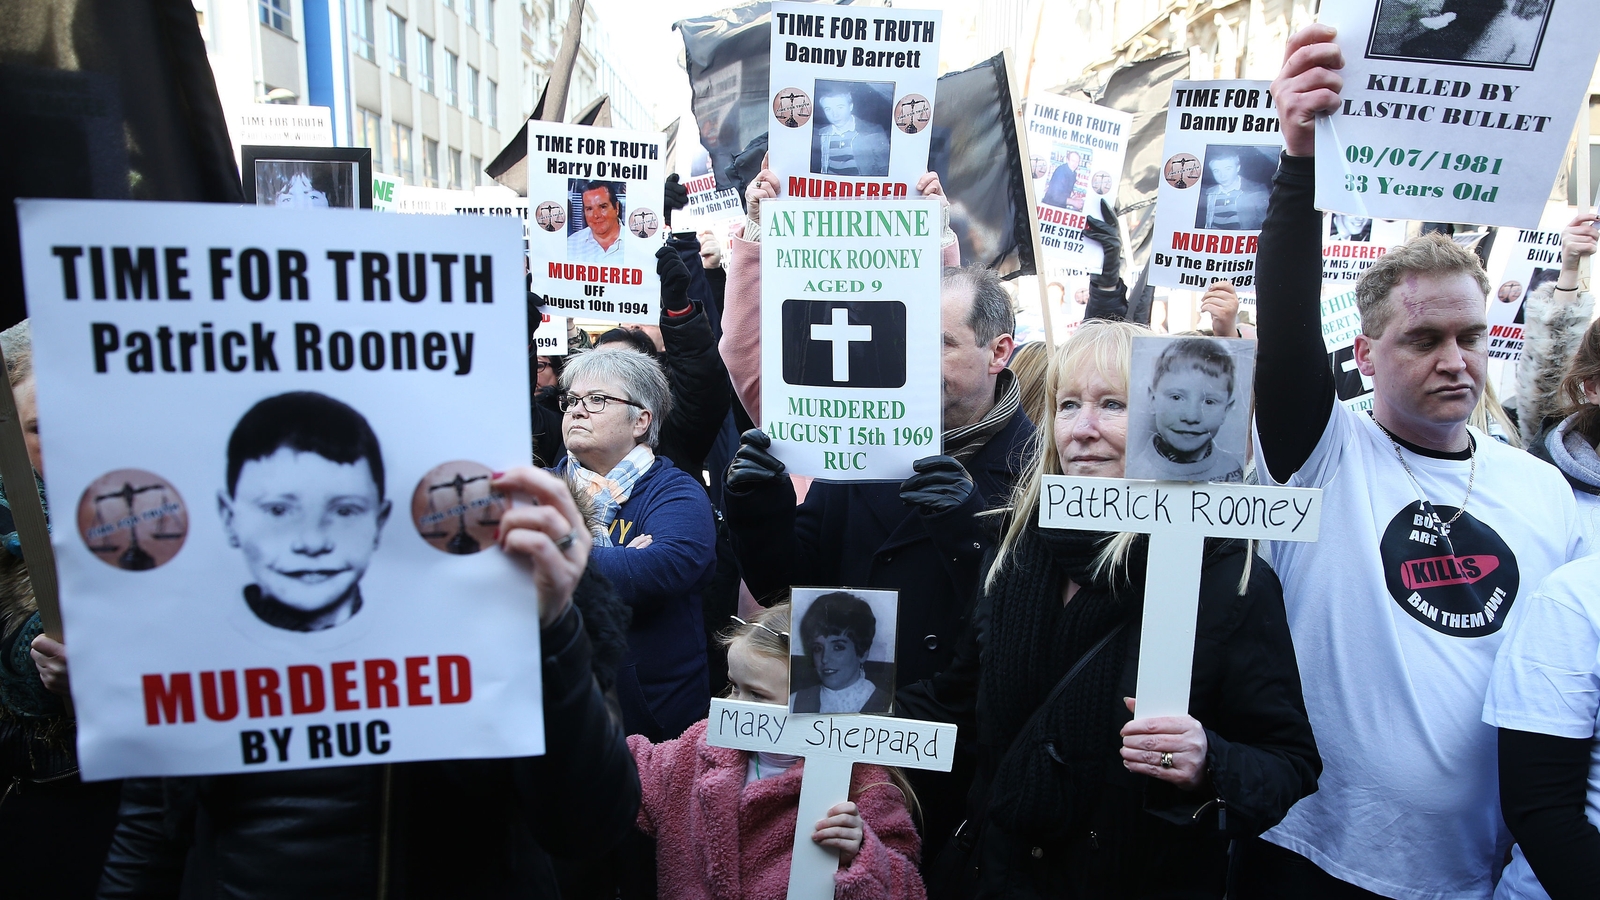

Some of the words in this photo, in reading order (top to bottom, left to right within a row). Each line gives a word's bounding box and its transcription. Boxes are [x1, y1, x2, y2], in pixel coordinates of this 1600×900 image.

[777, 13, 825, 38] TIME
[830, 16, 867, 41] FOR
[873, 19, 935, 43] TRUTH
[785, 42, 847, 68] Danny
[852, 46, 921, 69] Barrett
[1175, 89, 1221, 108] TIME
[1224, 89, 1260, 109] FOR
[1366, 73, 1471, 98] KILLED
[1477, 83, 1520, 103] BY
[292, 117, 325, 127] TRUTH
[1033, 103, 1059, 122] TIME
[1062, 110, 1082, 127] FOR
[1086, 116, 1121, 136] TRUTH
[1180, 113, 1239, 133] Danny
[1440, 107, 1552, 133] BULLET
[535, 134, 573, 154] TIME
[577, 137, 606, 157] FOR
[610, 140, 659, 161] TRUTH
[1029, 119, 1068, 140] Frankie
[1070, 129, 1119, 153] McKeown
[547, 157, 593, 178] Harry
[597, 161, 648, 181] O'Neill
[1345, 144, 1504, 176] 09/07/1981
[690, 195, 699, 206] BY
[700, 192, 713, 203] THE
[788, 176, 908, 200] MURDERED
[1344, 173, 1368, 194] 33
[1376, 176, 1445, 199] Years
[1452, 182, 1499, 203] Old
[706, 202, 722, 214] 16th
[723, 197, 740, 209] 1972
[768, 211, 796, 237] AN
[803, 209, 930, 238] FHIRINNE
[1040, 223, 1057, 235] THE
[1058, 227, 1085, 241] STATE
[1041, 236, 1061, 249] 16th
[1063, 241, 1085, 253] 1972
[1518, 230, 1545, 245] TIME
[776, 248, 842, 270] PATRICK
[847, 248, 922, 270] ROONEY
[1154, 253, 1172, 267] By
[1176, 255, 1202, 270] The
[1206, 258, 1254, 272] British
[1330, 260, 1349, 269] MI5
[1527, 248, 1554, 264] Billy
[51, 246, 191, 302] TIME
[209, 248, 311, 302] FOR
[327, 250, 494, 304] TRUTH
[548, 262, 643, 286] MURDERED
[1179, 273, 1207, 288] July
[584, 284, 606, 298] UFF
[803, 280, 865, 293] AGED
[872, 279, 883, 293] 9
[542, 294, 586, 312] August
[588, 299, 615, 313] 10th
[618, 302, 649, 315] 1994
[91, 322, 281, 374] Patrick
[294, 322, 475, 376] Rooney
[533, 337, 558, 348] 994
[1491, 339, 1504, 348] BY
[788, 396, 906, 420] MURDERED
[767, 421, 842, 445] AUGUST
[848, 425, 886, 447] 15th
[893, 427, 934, 448] 1969
[823, 451, 867, 471] RUC
[1409, 529, 1438, 547] ARE
[1407, 591, 1438, 622] BAN
[1441, 611, 1486, 628] THEM
[141, 654, 473, 727] MURDERED
[240, 726, 293, 765] BY
[307, 720, 391, 759] RUC
